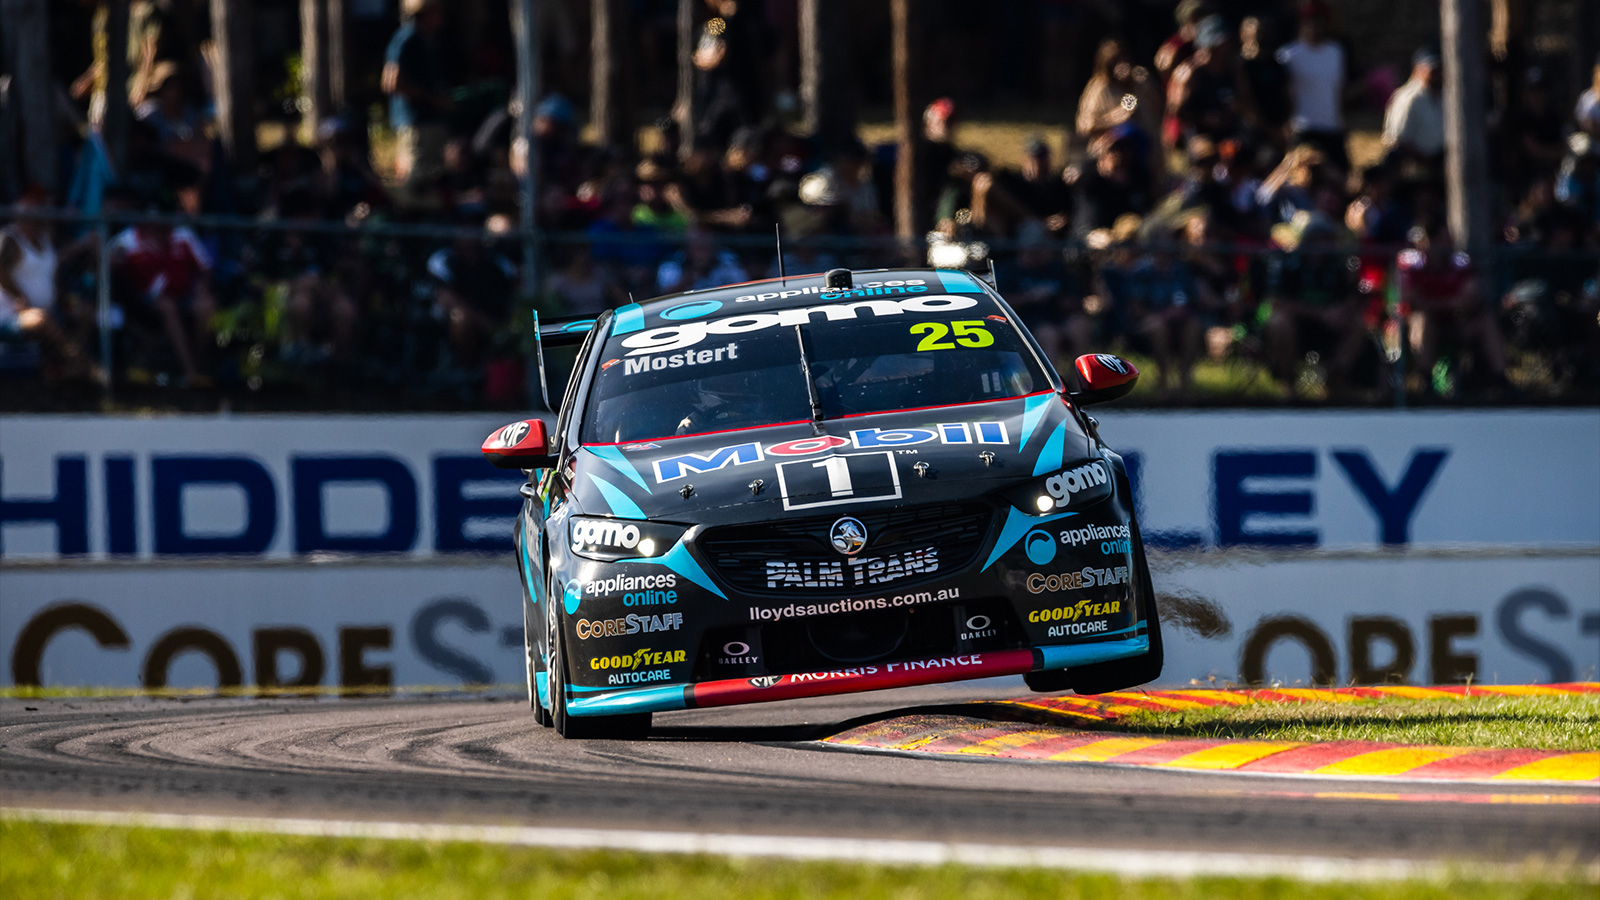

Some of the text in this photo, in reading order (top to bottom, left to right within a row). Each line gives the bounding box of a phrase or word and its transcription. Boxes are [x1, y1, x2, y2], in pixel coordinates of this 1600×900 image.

[620, 295, 978, 357] gomo
[909, 320, 995, 351] 25
[624, 343, 738, 376] Mostert
[651, 422, 1010, 484] Mobil
[812, 454, 853, 497] 1
[1045, 463, 1107, 507] gomo
[1121, 448, 1450, 547] LEY
[572, 520, 641, 552] gomo
[1059, 523, 1131, 547] appliances
[765, 547, 939, 588] PALM TRANS
[585, 573, 676, 597] appliances
[622, 590, 678, 607] online
[749, 586, 960, 622] lloydsauctions.com.au
[960, 629, 997, 641] OAKLEY
[1047, 620, 1108, 638] AUTOCARE
[717, 656, 759, 665] OAKLEY
[790, 665, 878, 683] MORRIS
[886, 653, 983, 673] FINANCE
[608, 669, 672, 685] AUTOCARE
